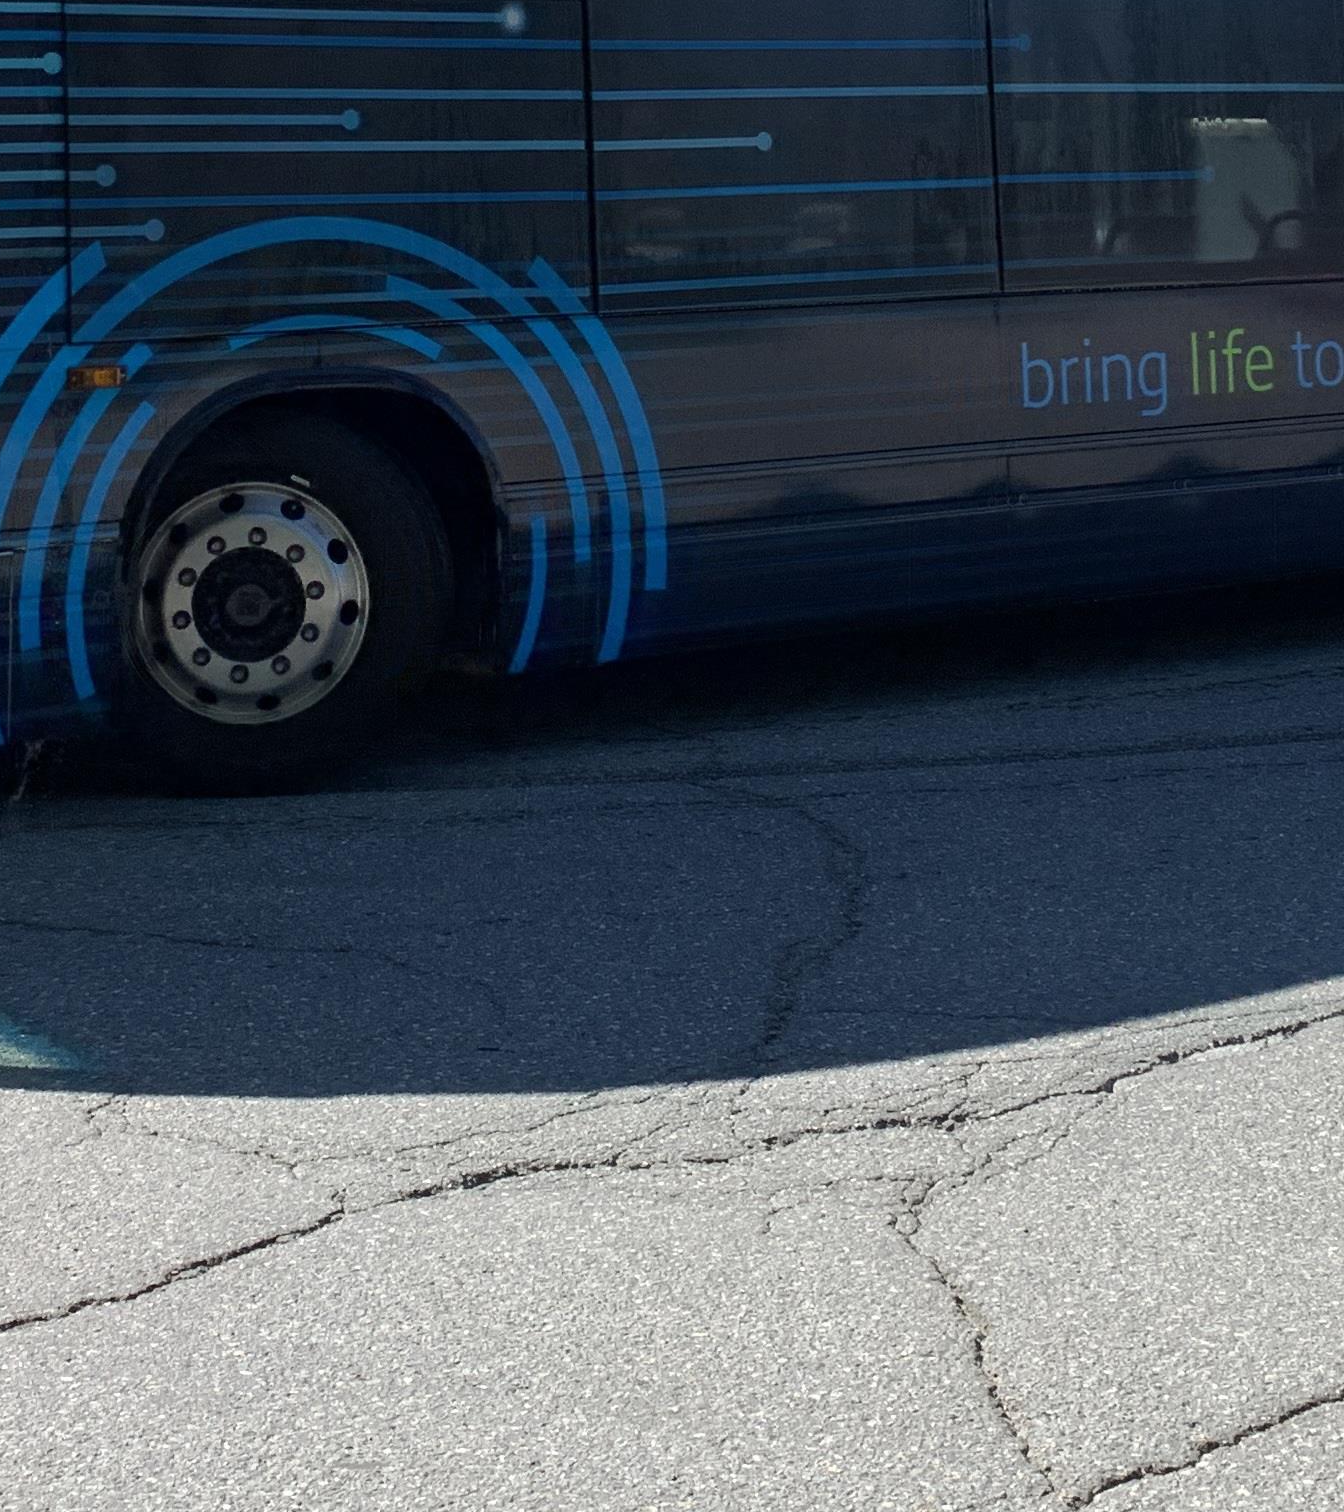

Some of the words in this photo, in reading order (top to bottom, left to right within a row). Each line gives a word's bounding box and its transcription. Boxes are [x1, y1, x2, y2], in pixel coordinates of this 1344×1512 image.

[1021, 337, 1168, 416] bring
[1190, 327, 1274, 395] life
[1290, 330, 1344, 389] to
